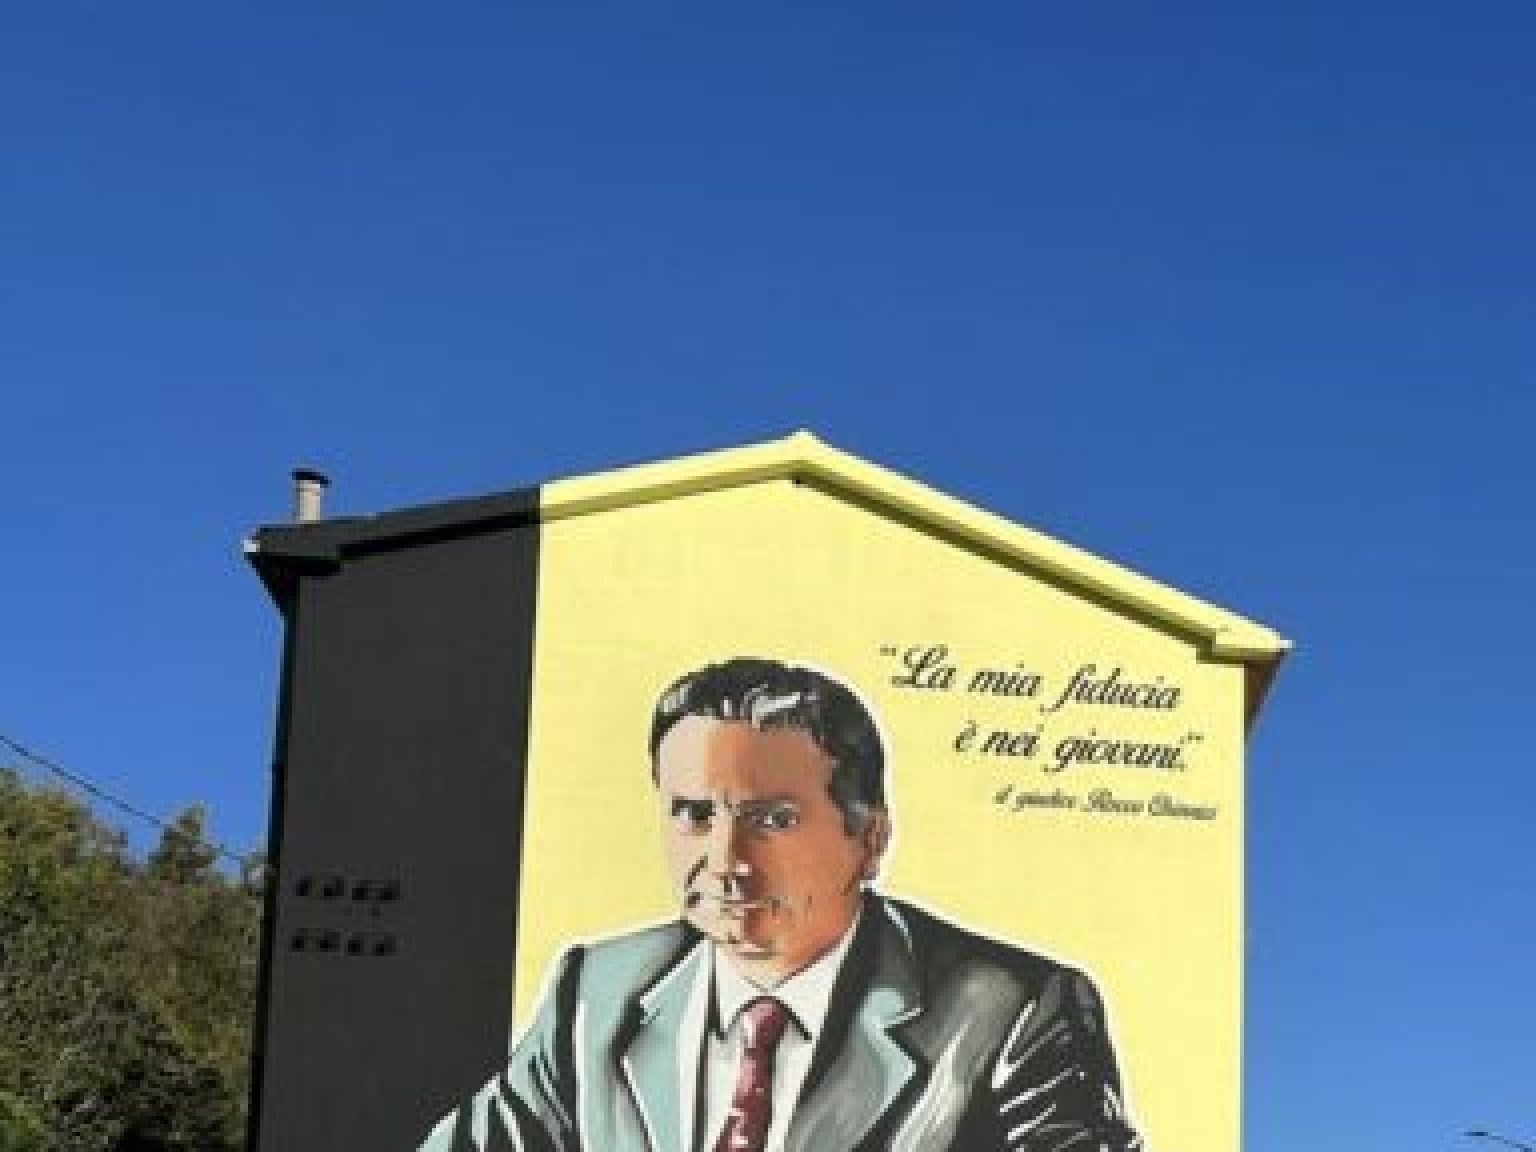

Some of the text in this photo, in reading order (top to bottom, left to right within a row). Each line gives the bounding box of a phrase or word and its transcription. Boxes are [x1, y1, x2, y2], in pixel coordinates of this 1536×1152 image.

[968, 661, 1041, 697] mia
[1040, 663, 1181, 713] fiducia
[953, 719, 976, 752] è
[981, 724, 1044, 757] nei
